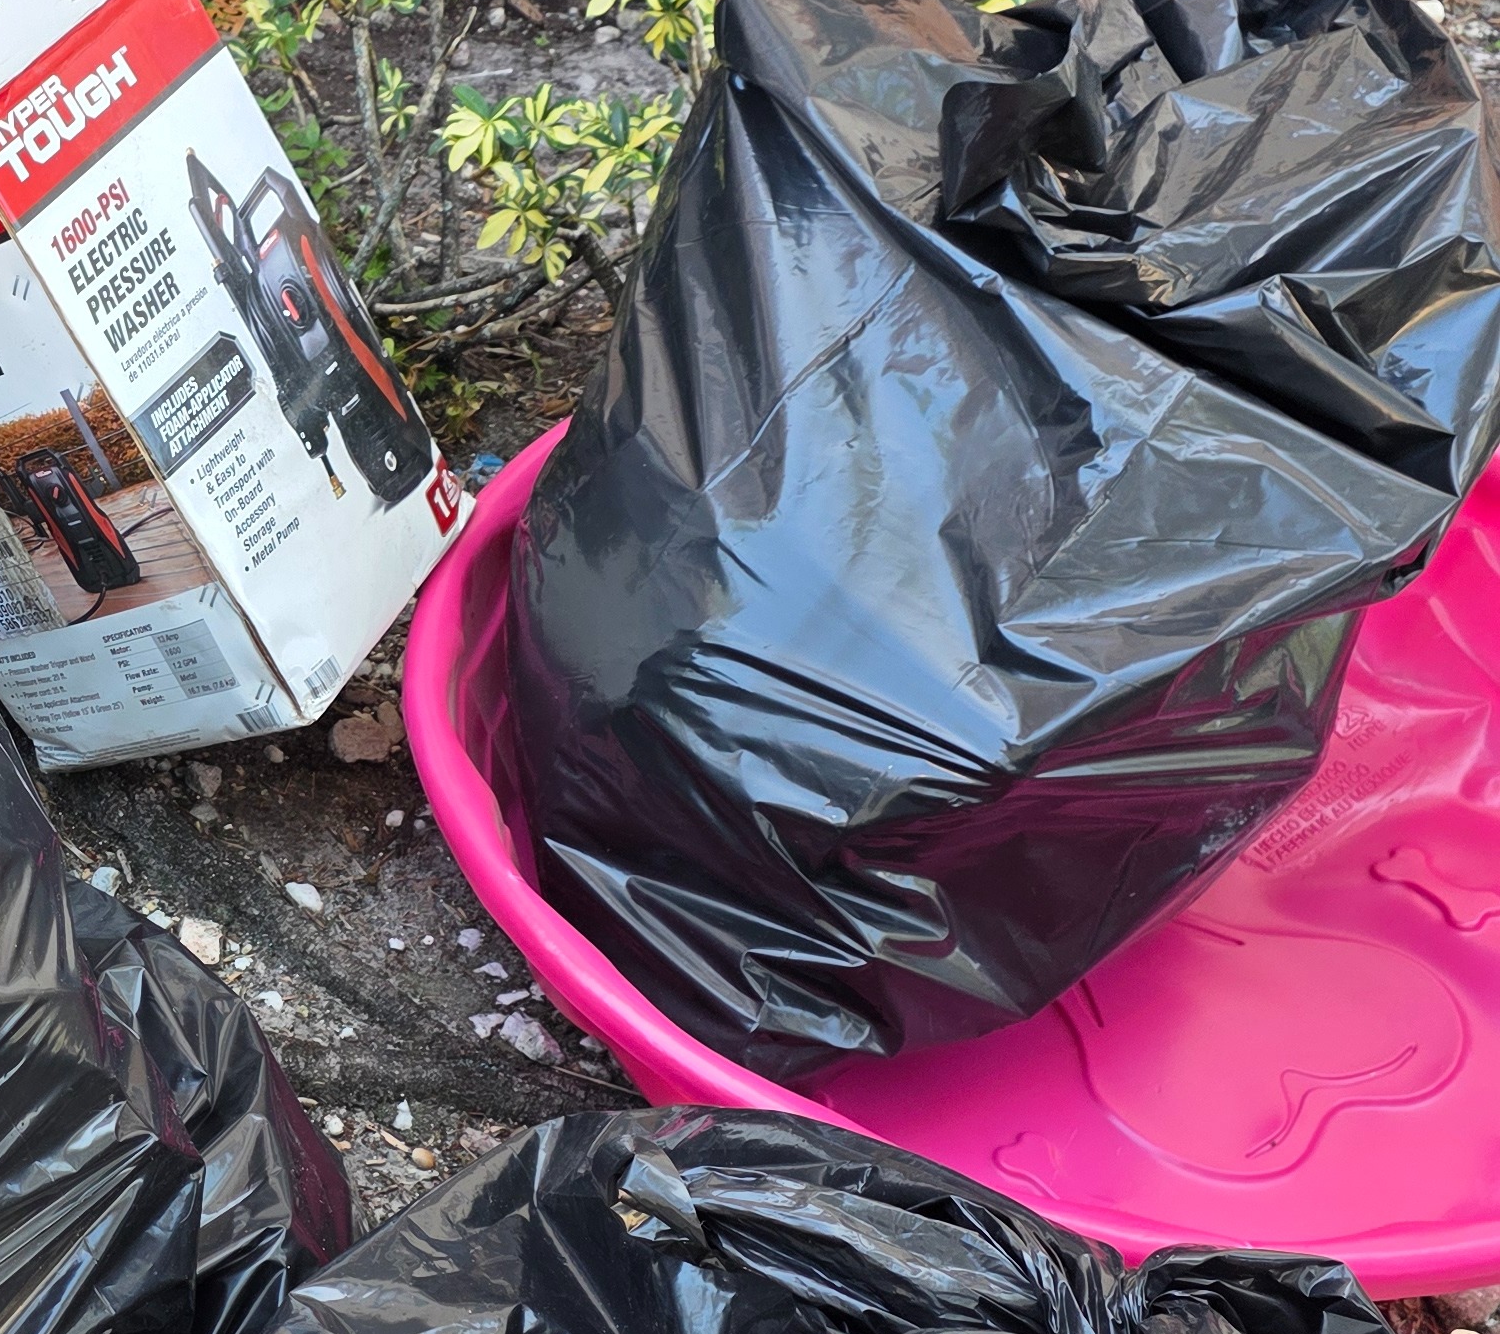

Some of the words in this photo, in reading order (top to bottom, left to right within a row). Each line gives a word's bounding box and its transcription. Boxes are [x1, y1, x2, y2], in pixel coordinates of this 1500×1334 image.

[51, 177, 130, 262] 1600-PSI
[68, 208, 148, 295] ELECTRIC
[86, 227, 177, 325] PRESSURE
[103, 271, 181, 354] WASHER
[121, 340, 152, 372] Lavadora
[152, 317, 181, 342] eléctrica
[181, 309, 186, 317] a
[186, 286, 208, 314] presión
[128, 370, 138, 383] de
[138, 345, 165, 374] 11031.6
[150, 375, 199, 429] INCLUDES
[158, 354, 244, 442] FOAM-APPLICATOR
[168, 389, 230, 458] ATTACHMENT
[196, 428, 246, 481] Lightweight
[206, 482, 215, 495] &
[215, 465, 236, 487] Easy
[236, 452, 247, 466] to
[214, 464, 257, 509] Transport
[256, 447, 276, 471] with
[224, 480, 264, 523] On-Board
[235, 492, 276, 538] Accessory
[243, 516, 277, 552] Storage
[252, 539, 277, 568] Metal
[276, 517, 300, 545] Pump
[102, 624, 153, 643] SPECIFICATIONS
[125, 673, 140, 681] Flow
[183, 657, 198, 667] GPM
[180, 672, 197, 682] Metal
